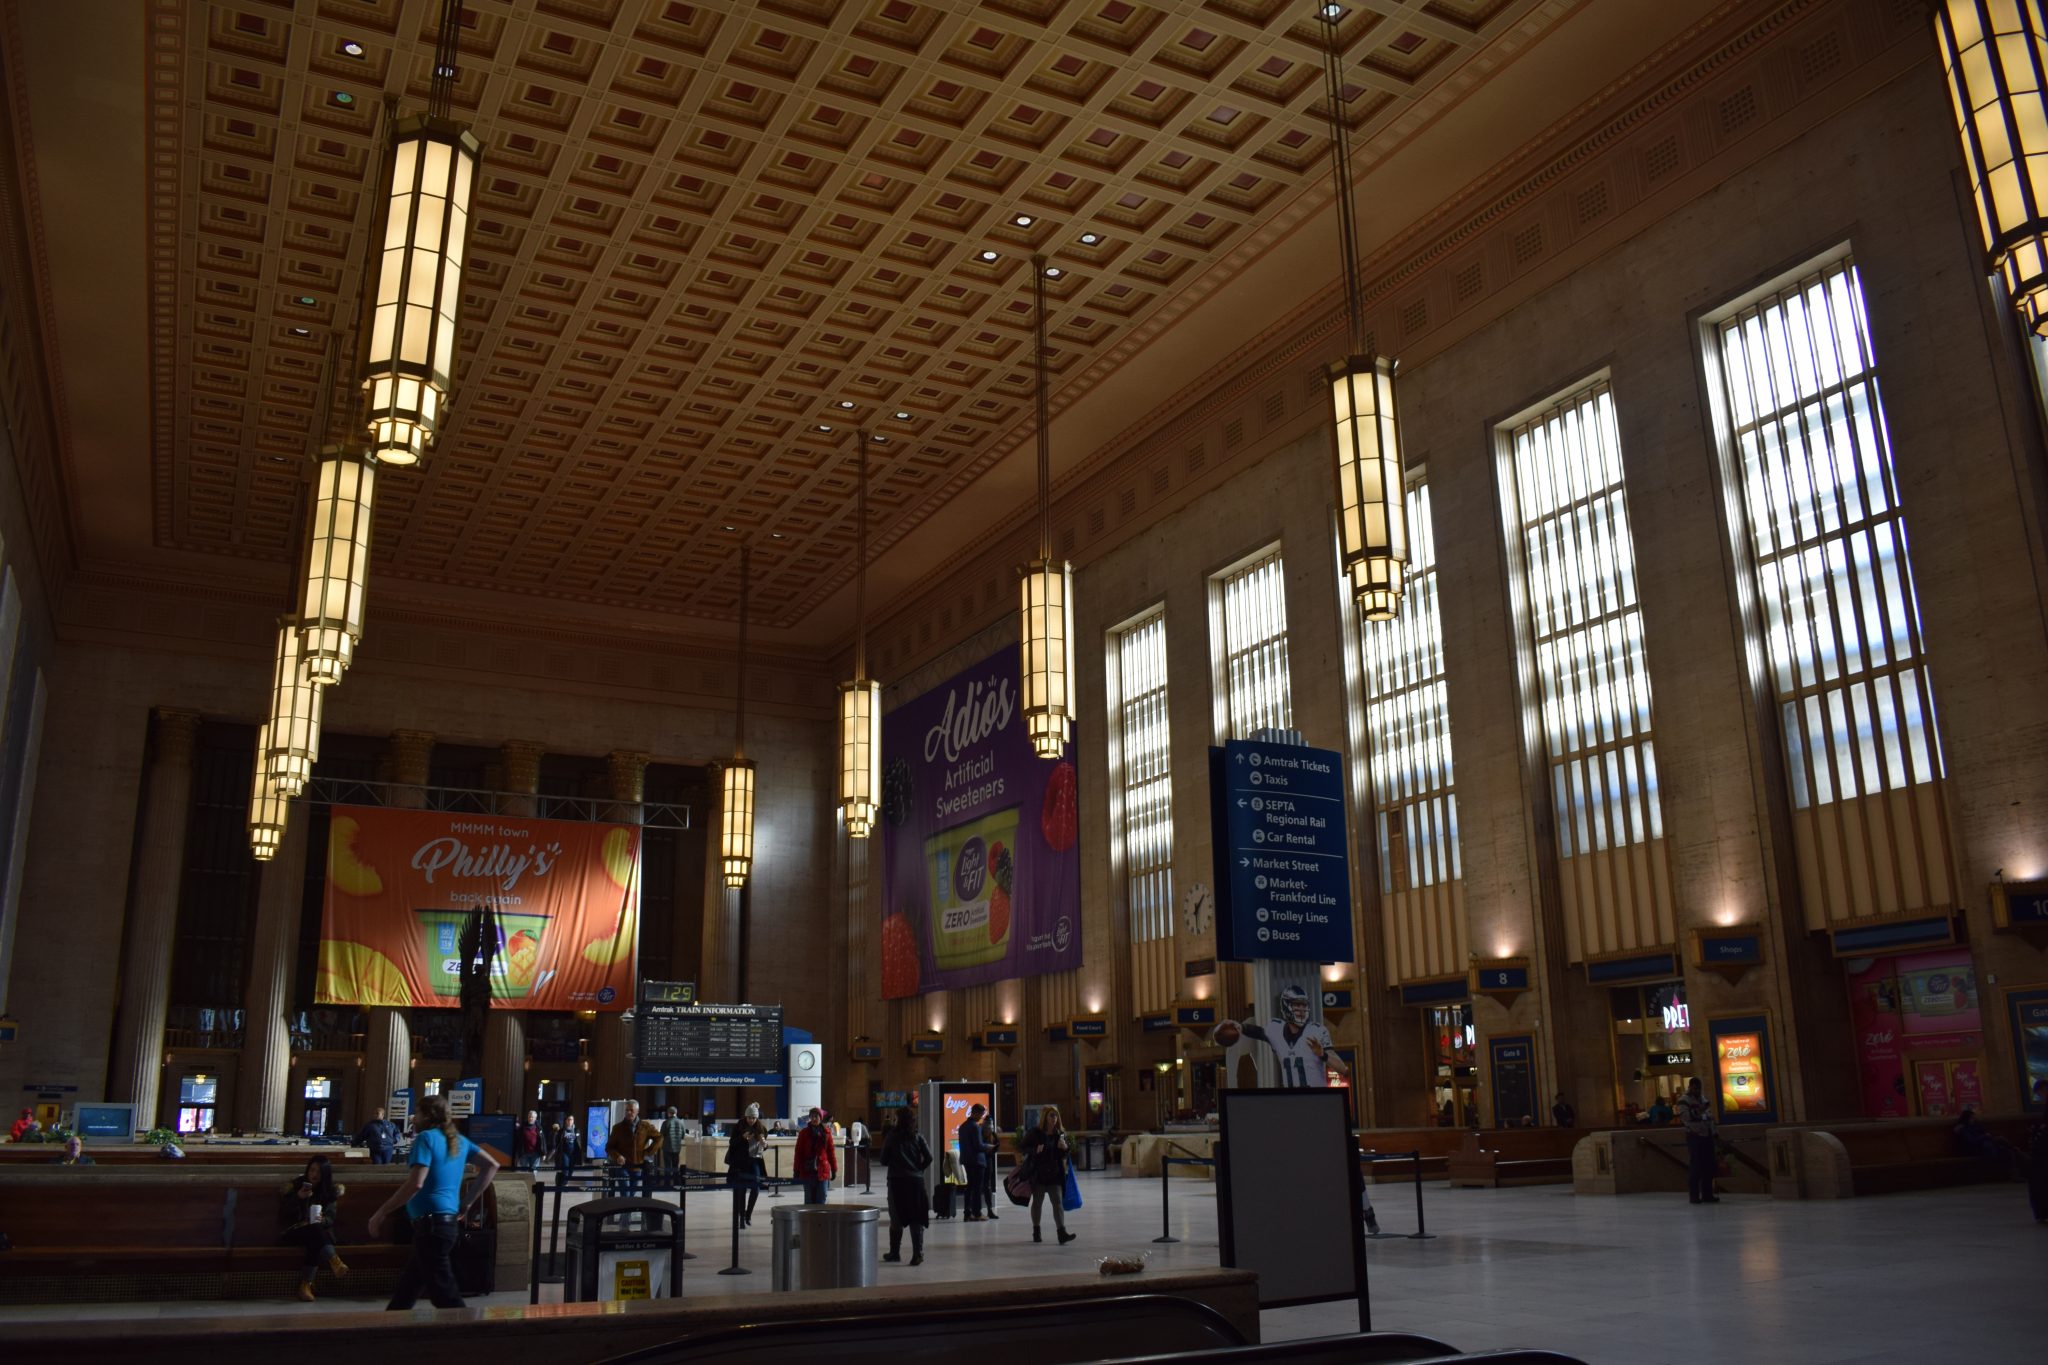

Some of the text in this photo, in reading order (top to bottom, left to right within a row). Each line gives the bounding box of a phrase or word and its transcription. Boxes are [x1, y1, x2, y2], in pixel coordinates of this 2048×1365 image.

[945, 750, 994, 791] Artificial
[1263, 755, 1331, 774] Amtrak Tickets
[1264, 774, 1288, 785] Taxis
[936, 777, 1005, 818] Sweeteners
[1265, 800, 1295, 812] SEPTA
[1266, 813, 1326, 828] Regional Rail
[450, 822, 529, 838] MMMM town
[1267, 832, 1316, 846] Car Rental
[411, 837, 556, 891] Philly's
[961, 852, 980, 876] Light
[1253, 858, 1319, 872] Market Street
[1269, 878, 1308, 890] Market-
[450, 890, 522, 906] back again
[1270, 891, 1337, 906] Frankford Line
[944, 910, 970, 929] ZERO
[1270, 910, 1329, 924] Trolley Lines
[1272, 930, 1301, 941] Buses
[1719, 945, 1743, 954] Shops
[1498, 972, 1508, 985] 8
[652, 1005, 756, 1015] Amtrak TRAIN INFORMATION
[1192, 1010, 1200, 1021] 6
[1283, 1056, 1307, 1088] 11
[672, 1075, 699, 1083] ClubAcela
[720, 1076, 743, 1084] Stairway
[946, 1096, 968, 1114] bye
